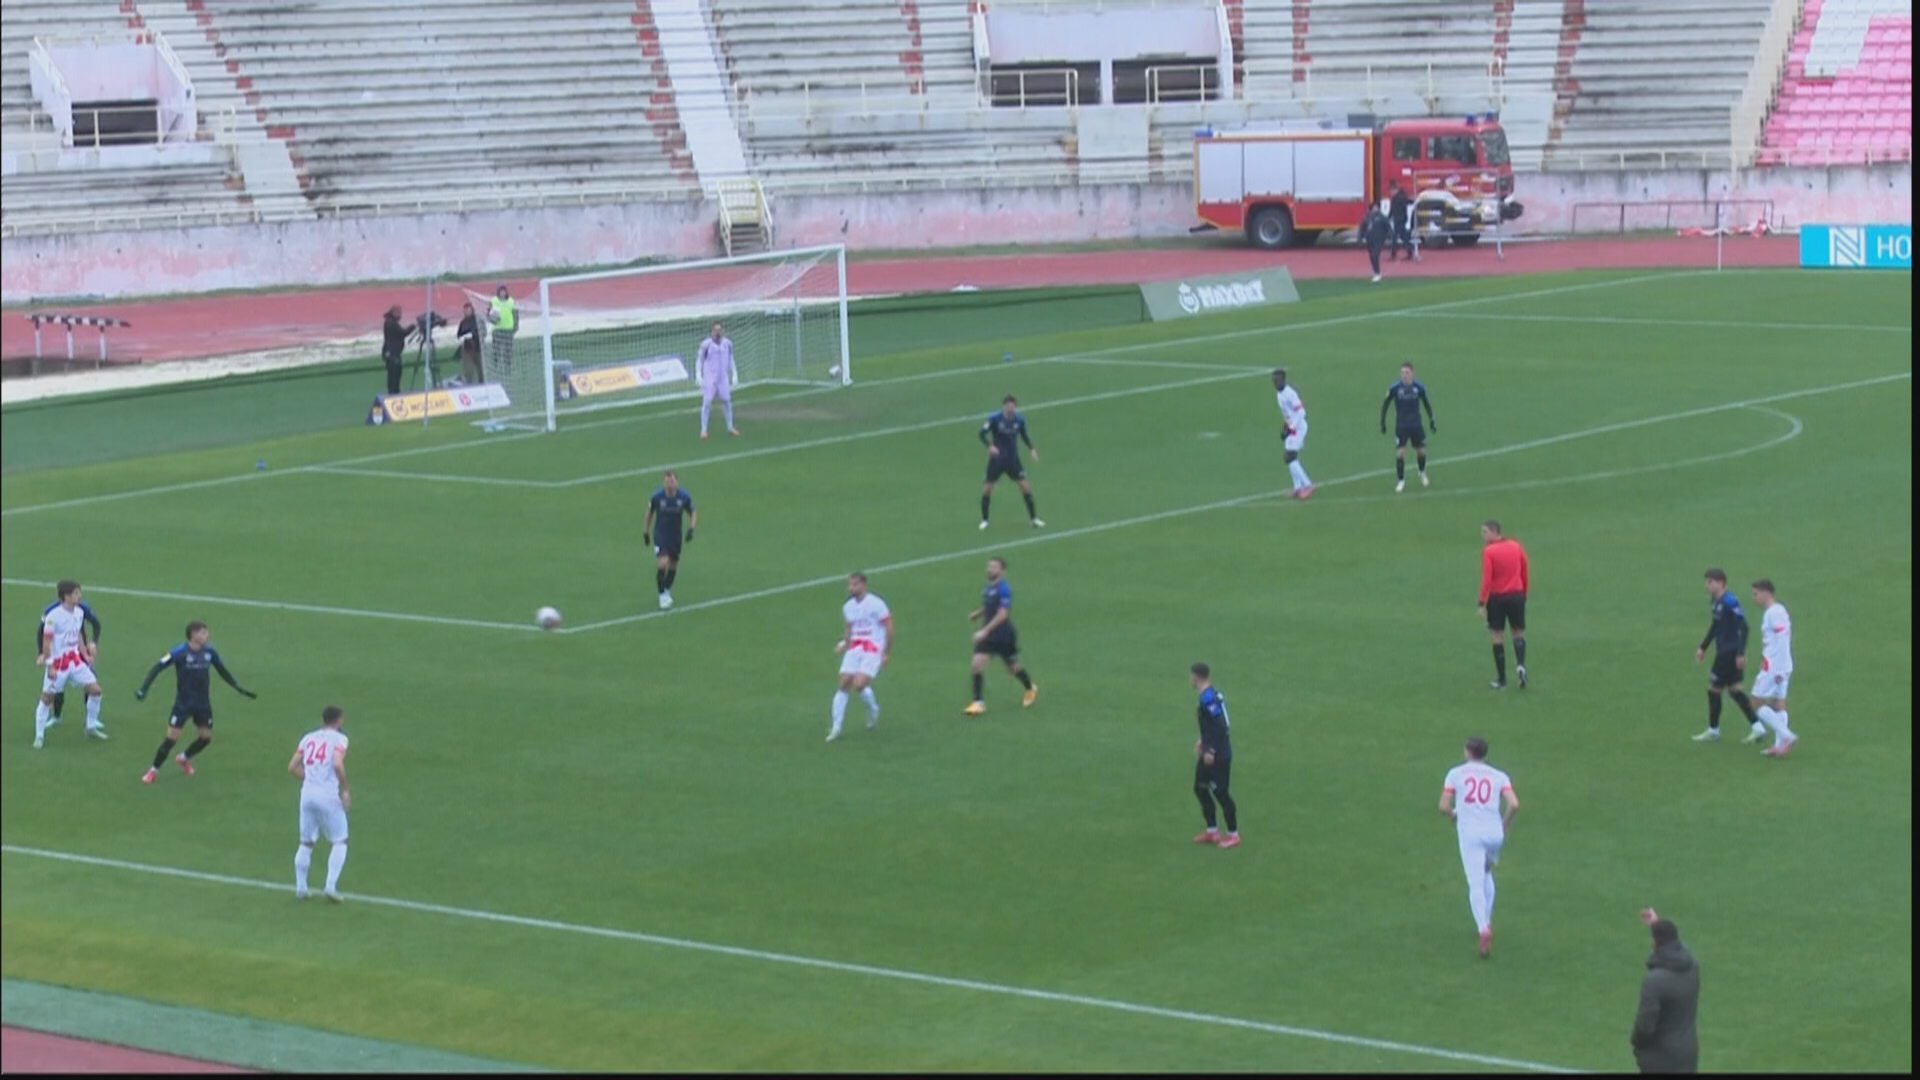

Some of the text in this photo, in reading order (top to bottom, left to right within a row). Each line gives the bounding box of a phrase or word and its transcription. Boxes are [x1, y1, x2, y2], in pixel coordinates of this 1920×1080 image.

[1877, 234, 1911, 260] HO
[305, 740, 327, 766] 24
[1463, 776, 1492, 805] 20
